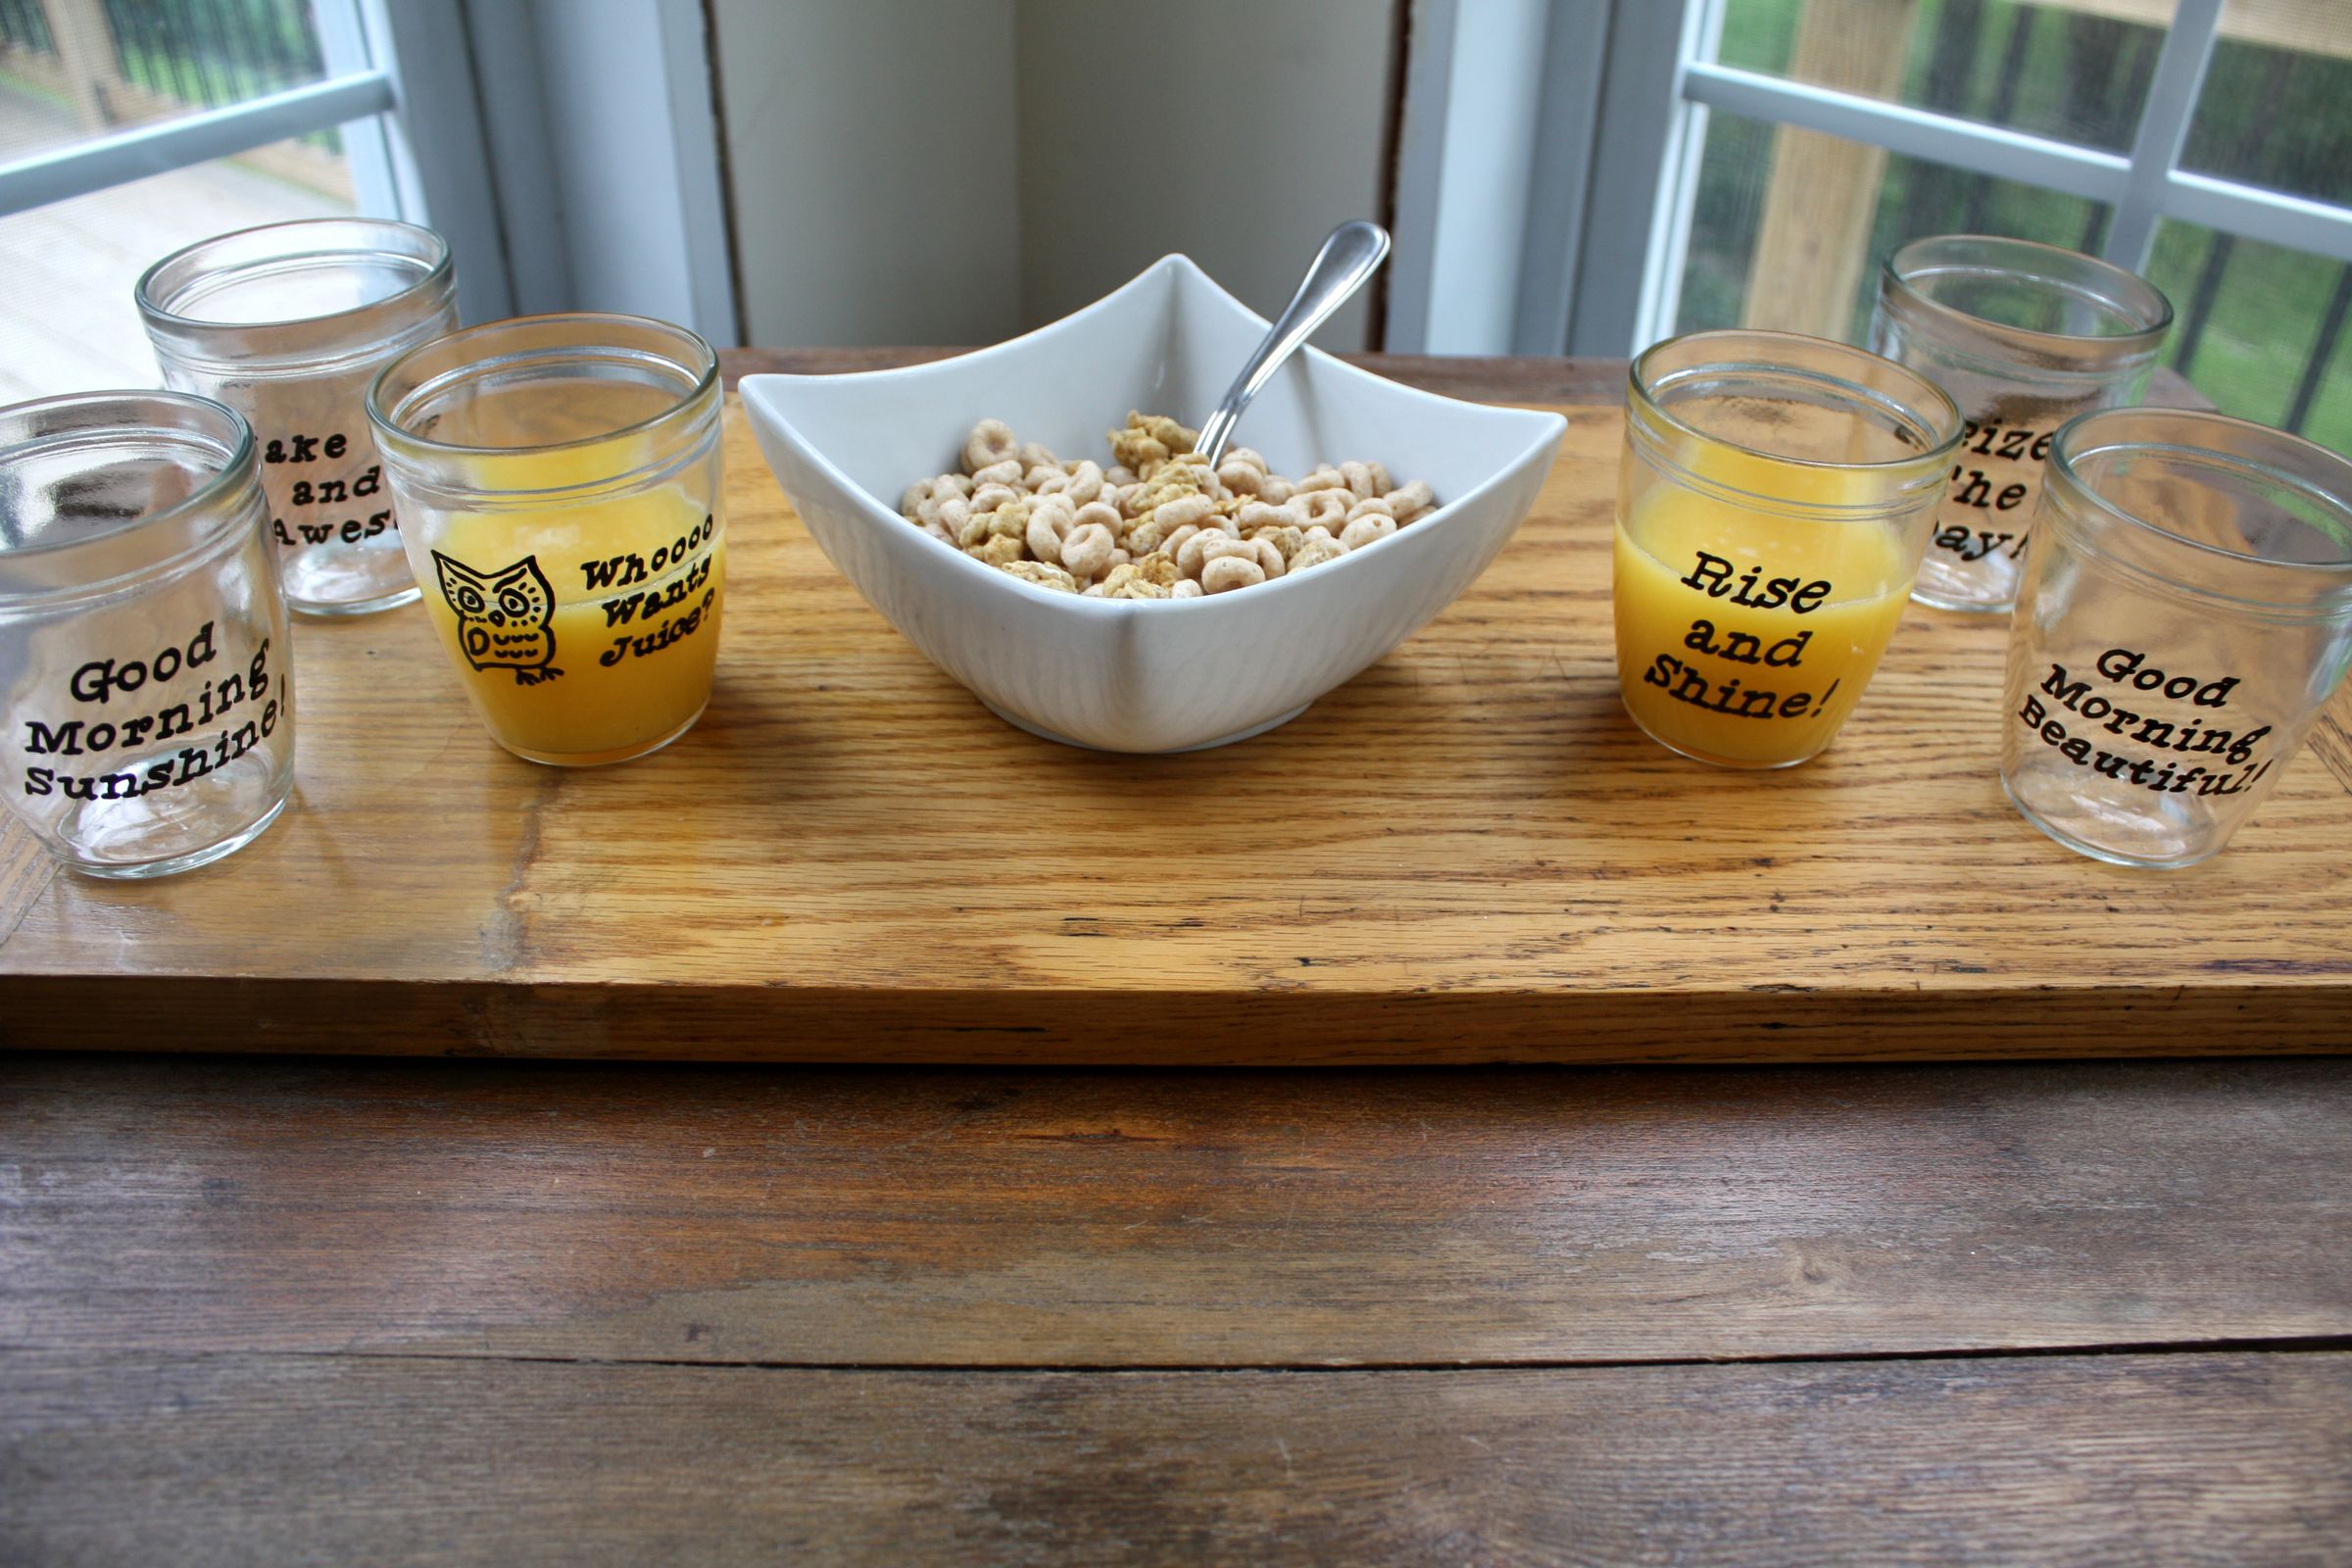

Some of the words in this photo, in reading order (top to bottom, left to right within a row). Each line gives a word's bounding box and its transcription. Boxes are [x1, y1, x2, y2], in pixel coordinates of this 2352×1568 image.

[255, 433, 347, 464] ake
[292, 465, 380, 506] and
[1951, 465, 2027, 511] he
[273, 509, 400, 546] Awes
[1933, 520, 2029, 561] ay!
[601, 554, 712, 627] Wants
[1681, 551, 1832, 614] Rise
[599, 588, 715, 667] Juice?
[1684, 619, 1813, 667] and
[71, 620, 218, 704] Good
[2096, 649, 2241, 708] Good
[24, 638, 270, 756] Morning
[2040, 663, 2272, 764] Morning
[2019, 694, 2274, 796] Beautiful!
